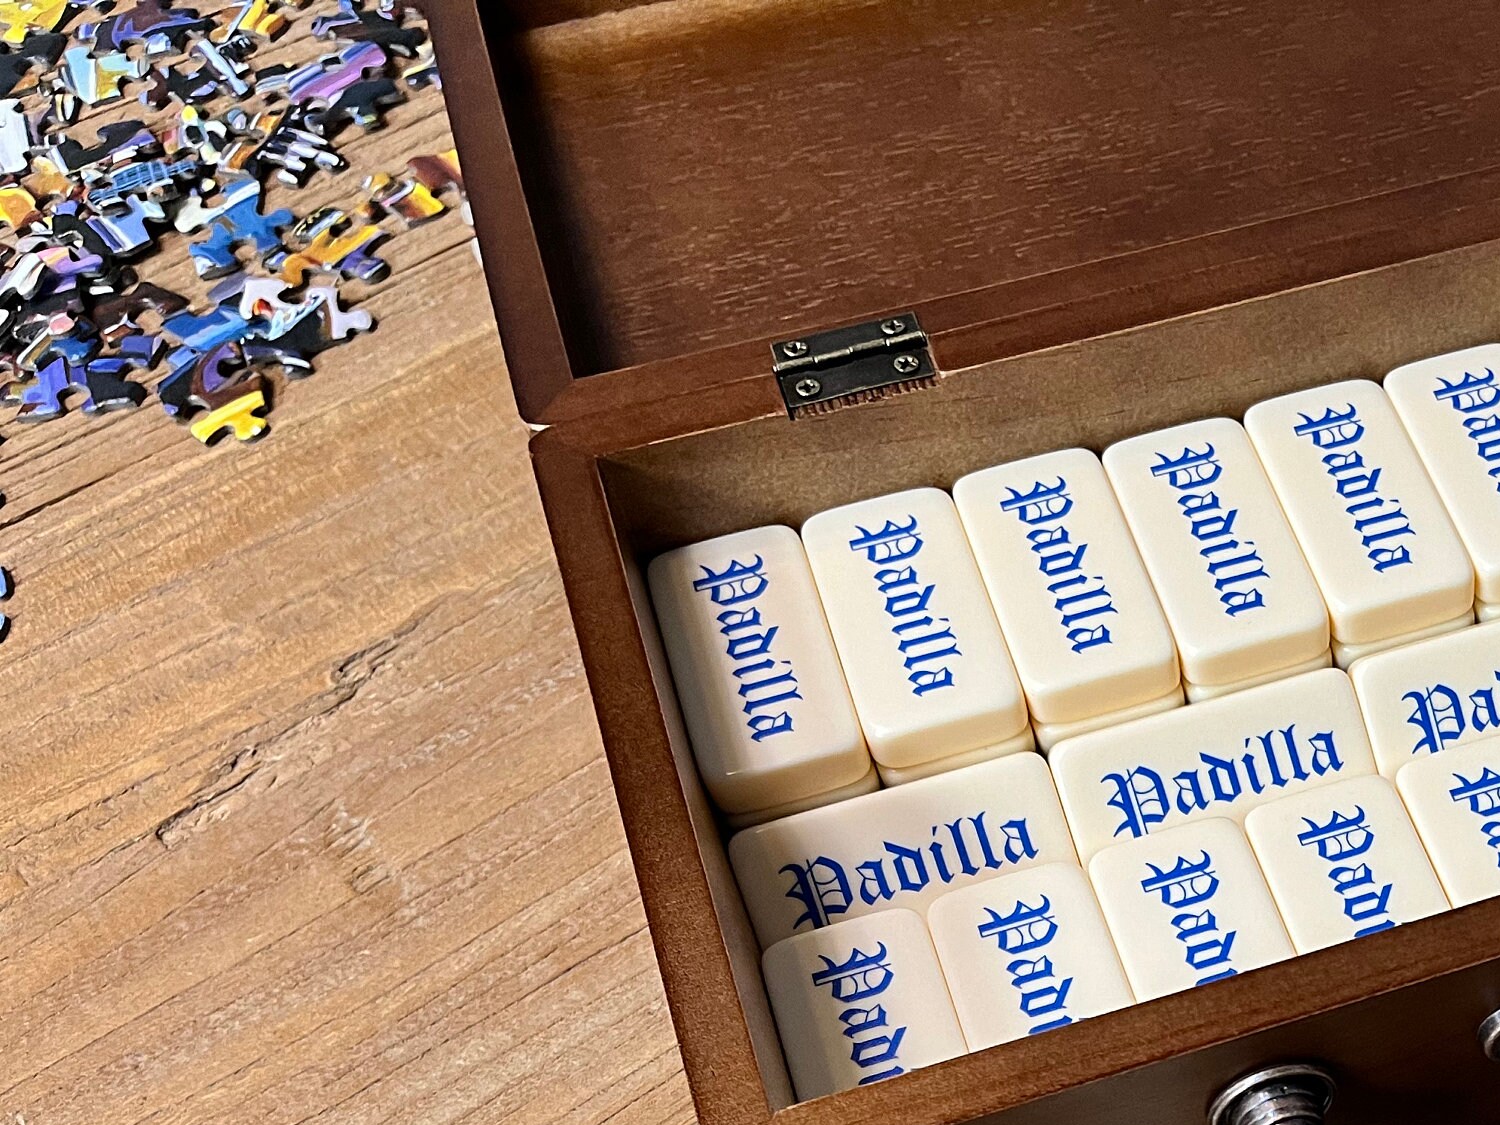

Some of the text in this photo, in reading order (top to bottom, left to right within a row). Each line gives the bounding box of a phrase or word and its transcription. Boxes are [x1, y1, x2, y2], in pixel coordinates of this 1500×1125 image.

[1000, 477, 1116, 653] Padilla
[1151, 443, 1269, 616] Padilla
[1294, 404, 1414, 572] Padilla
[692, 553, 803, 743] Padilla
[849, 516, 961, 697] Padilla
[1101, 724, 1344, 839] Padilla
[778, 811, 1040, 929] Padilla
